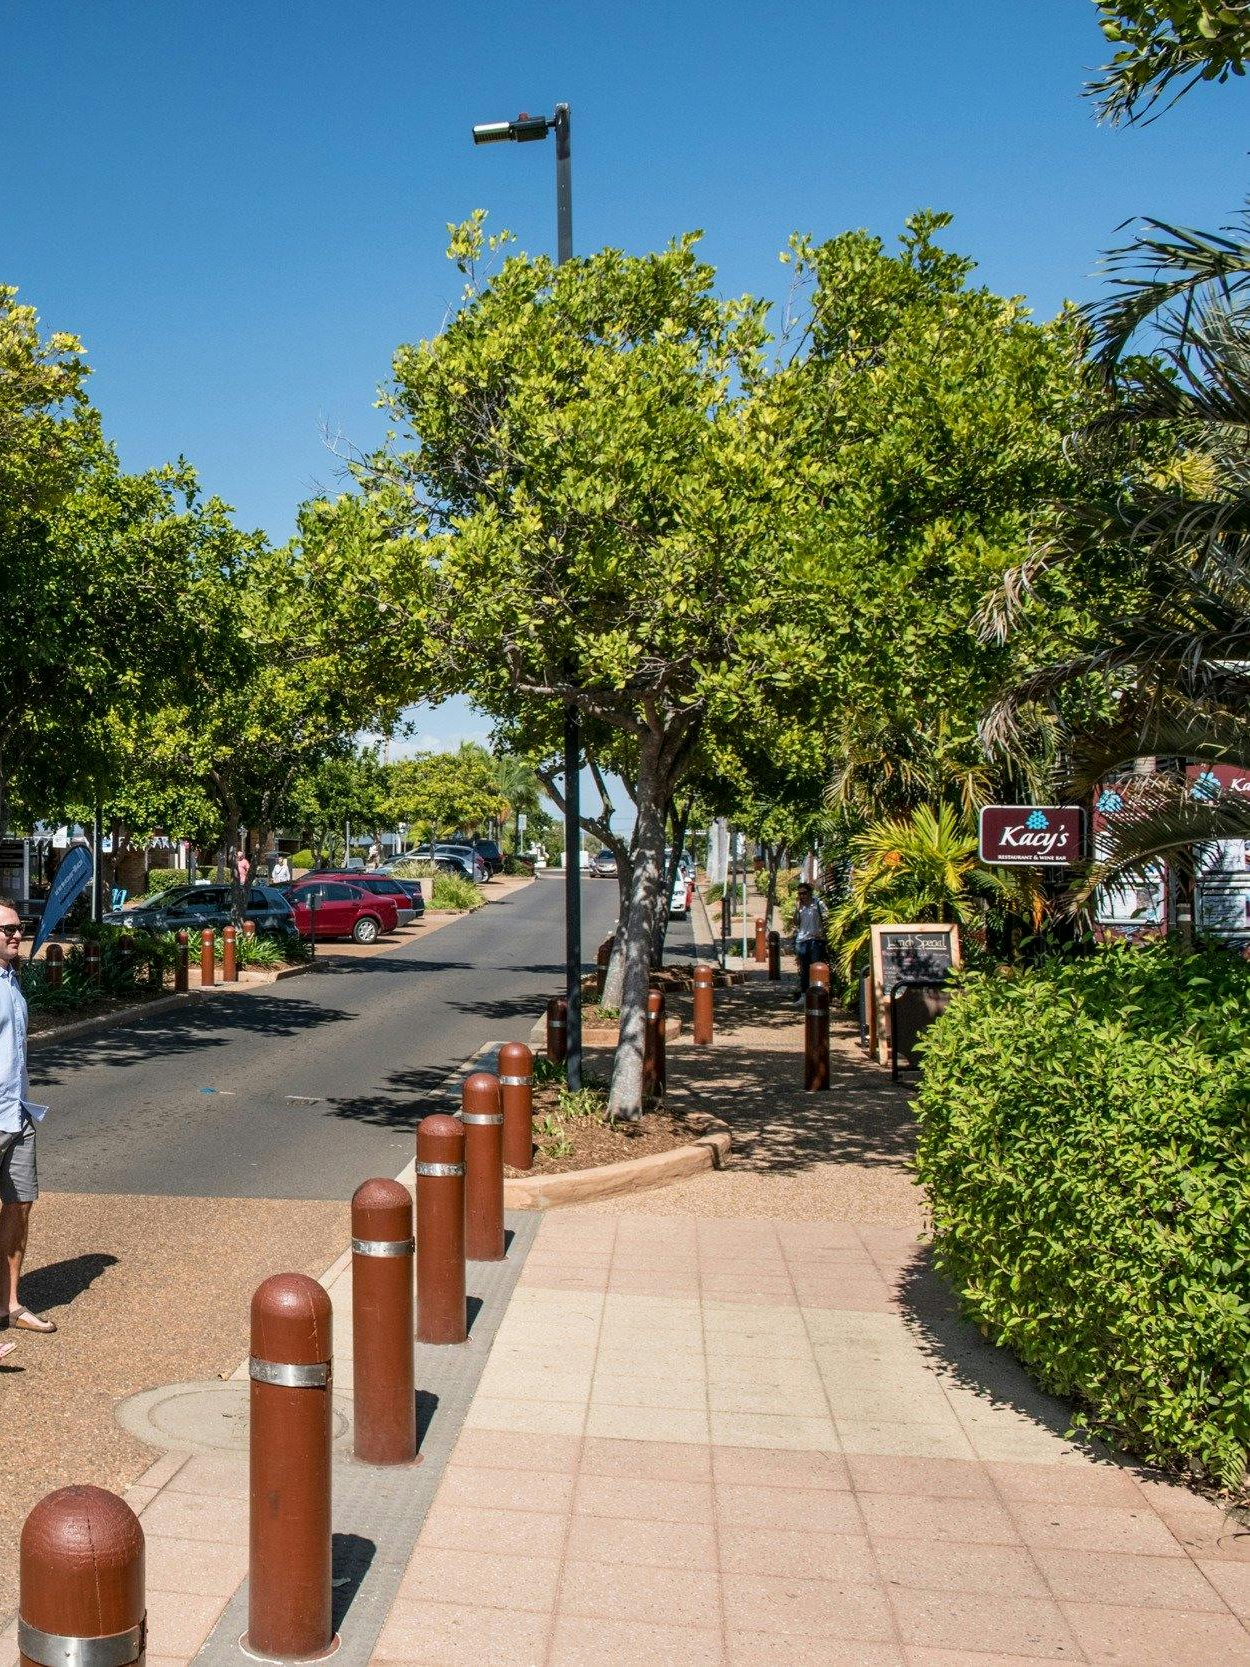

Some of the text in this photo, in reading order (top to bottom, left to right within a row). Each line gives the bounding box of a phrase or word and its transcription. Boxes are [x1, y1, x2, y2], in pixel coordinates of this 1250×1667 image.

[998, 824, 1070, 855] Kacy's
[886, 934, 947, 950] Lnch Special
